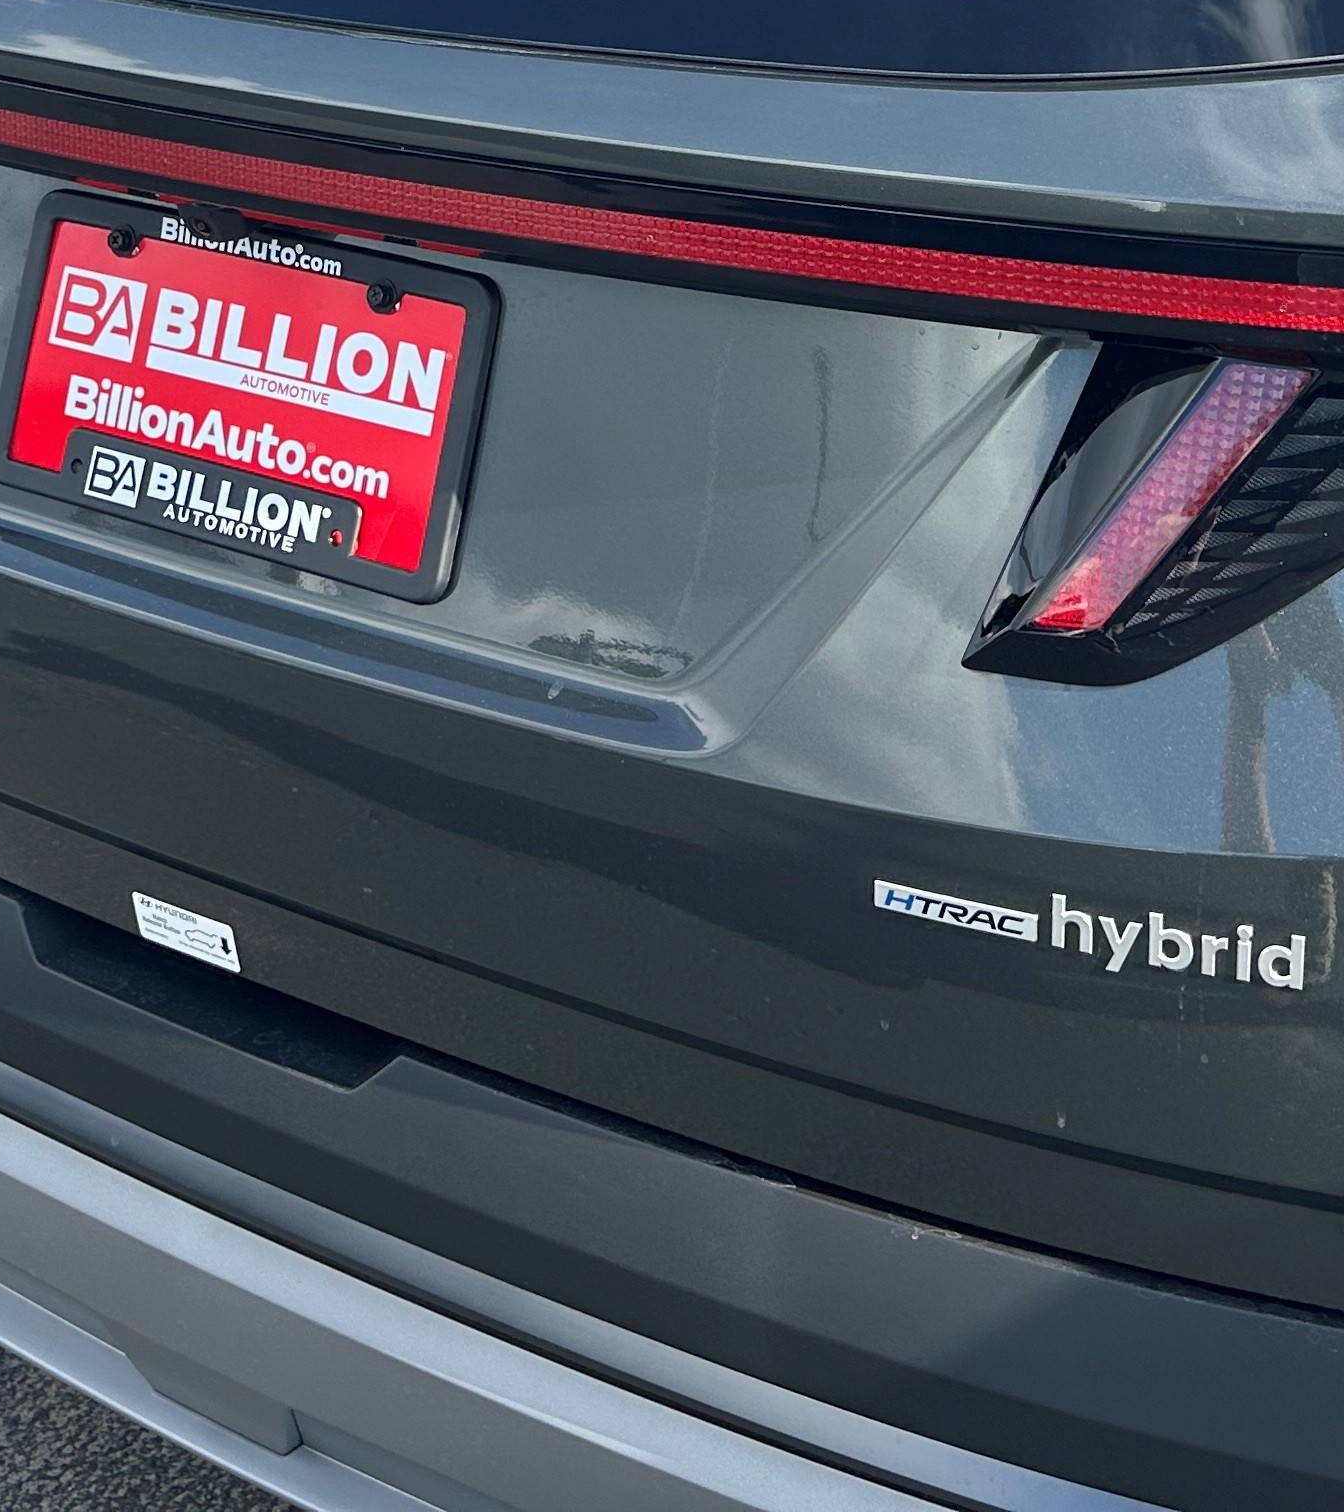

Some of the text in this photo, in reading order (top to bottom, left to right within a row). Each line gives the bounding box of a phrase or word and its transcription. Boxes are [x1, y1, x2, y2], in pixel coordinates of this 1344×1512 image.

[149, 287, 447, 412] BILLION
[239, 373, 331, 406] AUTOMOTIVE
[146, 461, 324, 544] BILLION
[162, 503, 297, 554] AUTOMOTIVE
[883, 889, 1307, 990] HTRAC hybrid
